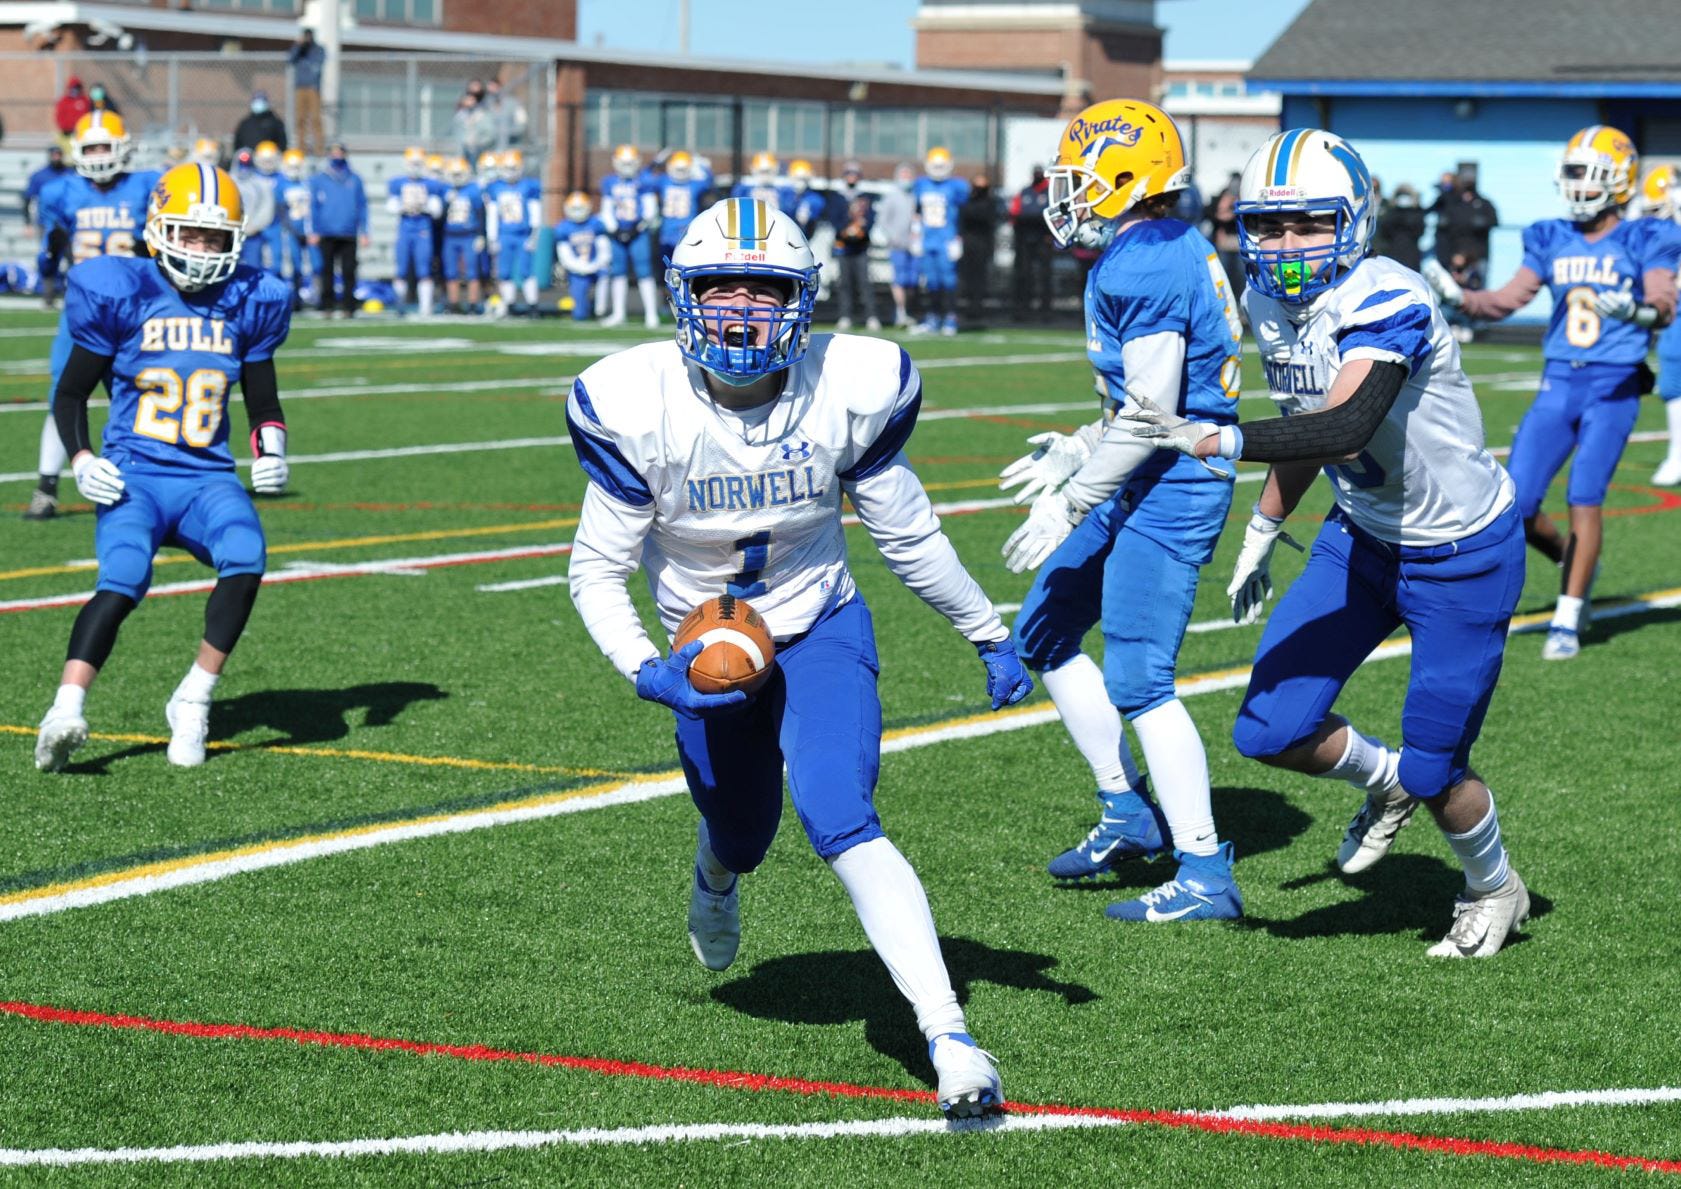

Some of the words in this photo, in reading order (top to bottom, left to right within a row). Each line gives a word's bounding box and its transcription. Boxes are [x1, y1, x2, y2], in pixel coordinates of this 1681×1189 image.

[1069, 115, 1144, 149] Pirates
[1269, 189, 1296, 197] Riddell
[76, 206, 136, 229] HULL
[725, 252, 766, 261] Rdell
[1552, 256, 1620, 286] HULL
[1566, 287, 1600, 348] 6
[141, 317, 233, 355] HULL
[133, 367, 228, 448] 28
[687, 466, 825, 512] NORWELL
[723, 528, 774, 598] 1
